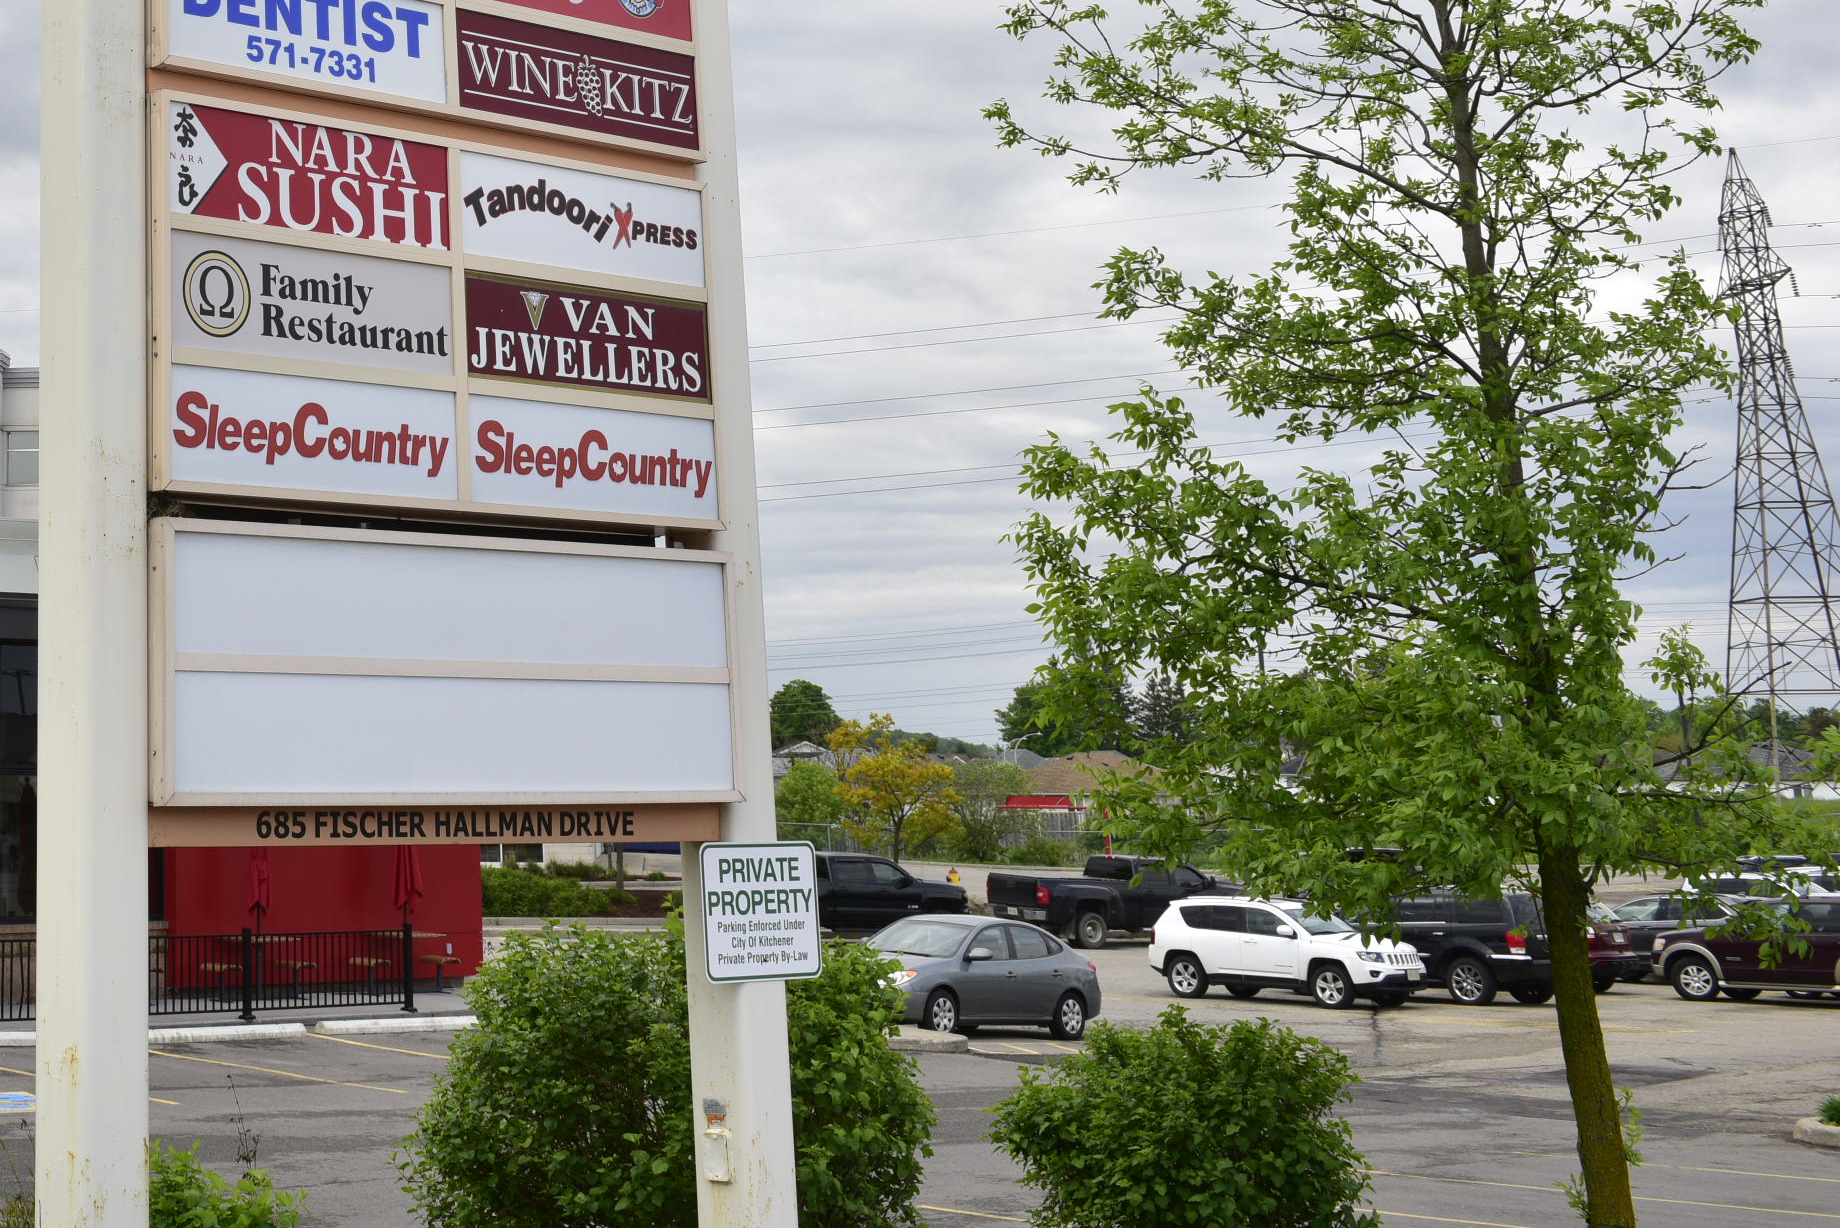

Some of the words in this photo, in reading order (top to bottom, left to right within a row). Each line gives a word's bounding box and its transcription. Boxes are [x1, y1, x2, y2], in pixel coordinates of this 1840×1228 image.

[246, 35, 377, 84] 571-7331
[462, 40, 578, 103] WINE
[599, 68, 693, 125] KITZ
[169, 151, 204, 165] NARA
[267, 119, 417, 185] NARA
[237, 162, 450, 252] SUSHI
[463, 178, 614, 244] Tandoori
[259, 263, 374, 315] Family
[260, 302, 449, 358] Restaurant
[559, 296, 656, 341] VAN
[470, 326, 702, 393] JEWELLERS
[173, 390, 450, 478] SleepCountry
[475, 419, 712, 499] SleepCountry
[256, 811, 307, 839] 685
[314, 811, 426, 839] FISCHER
[434, 811, 554, 838] HALLMAN
[560, 811, 634, 837] DRIVE
[718, 857, 801, 884] PRIVATE
[707, 888, 813, 916] PROPERTY
[717, 921, 747, 935] Parking
[748, 919, 781, 932] Enforced
[783, 919, 805, 931] Under
[718, 953, 745, 965] Private
[747, 951, 779, 965] Property
[781, 950, 809, 963] By-Law
[731, 936, 746, 950] City
[748, 936, 757, 948] Of
[759, 936, 794, 947] Kitchener
